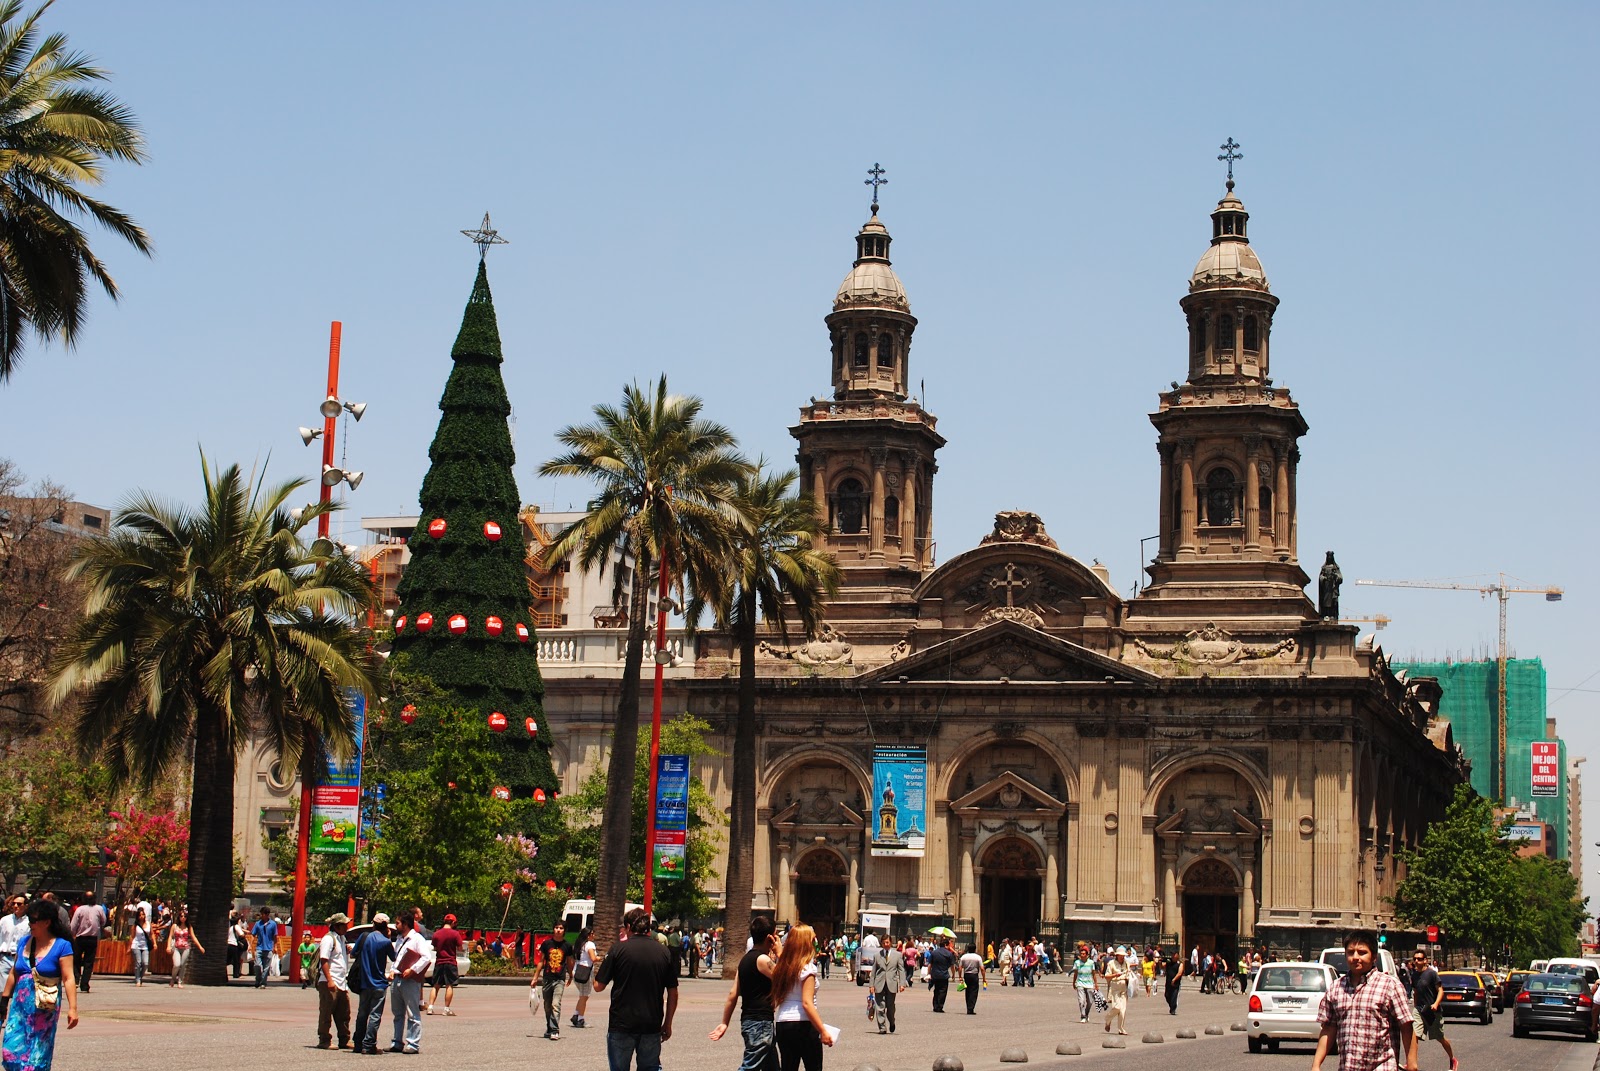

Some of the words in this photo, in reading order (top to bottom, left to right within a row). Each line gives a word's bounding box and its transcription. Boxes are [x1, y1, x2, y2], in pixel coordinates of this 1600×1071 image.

[1540, 745, 1549, 753] LO
[1532, 755, 1557, 765] MEJOR
[1539, 765, 1550, 774] DEL
[1532, 775, 1557, 783] CENTRO
[1507, 827, 1534, 836] ynapsis
